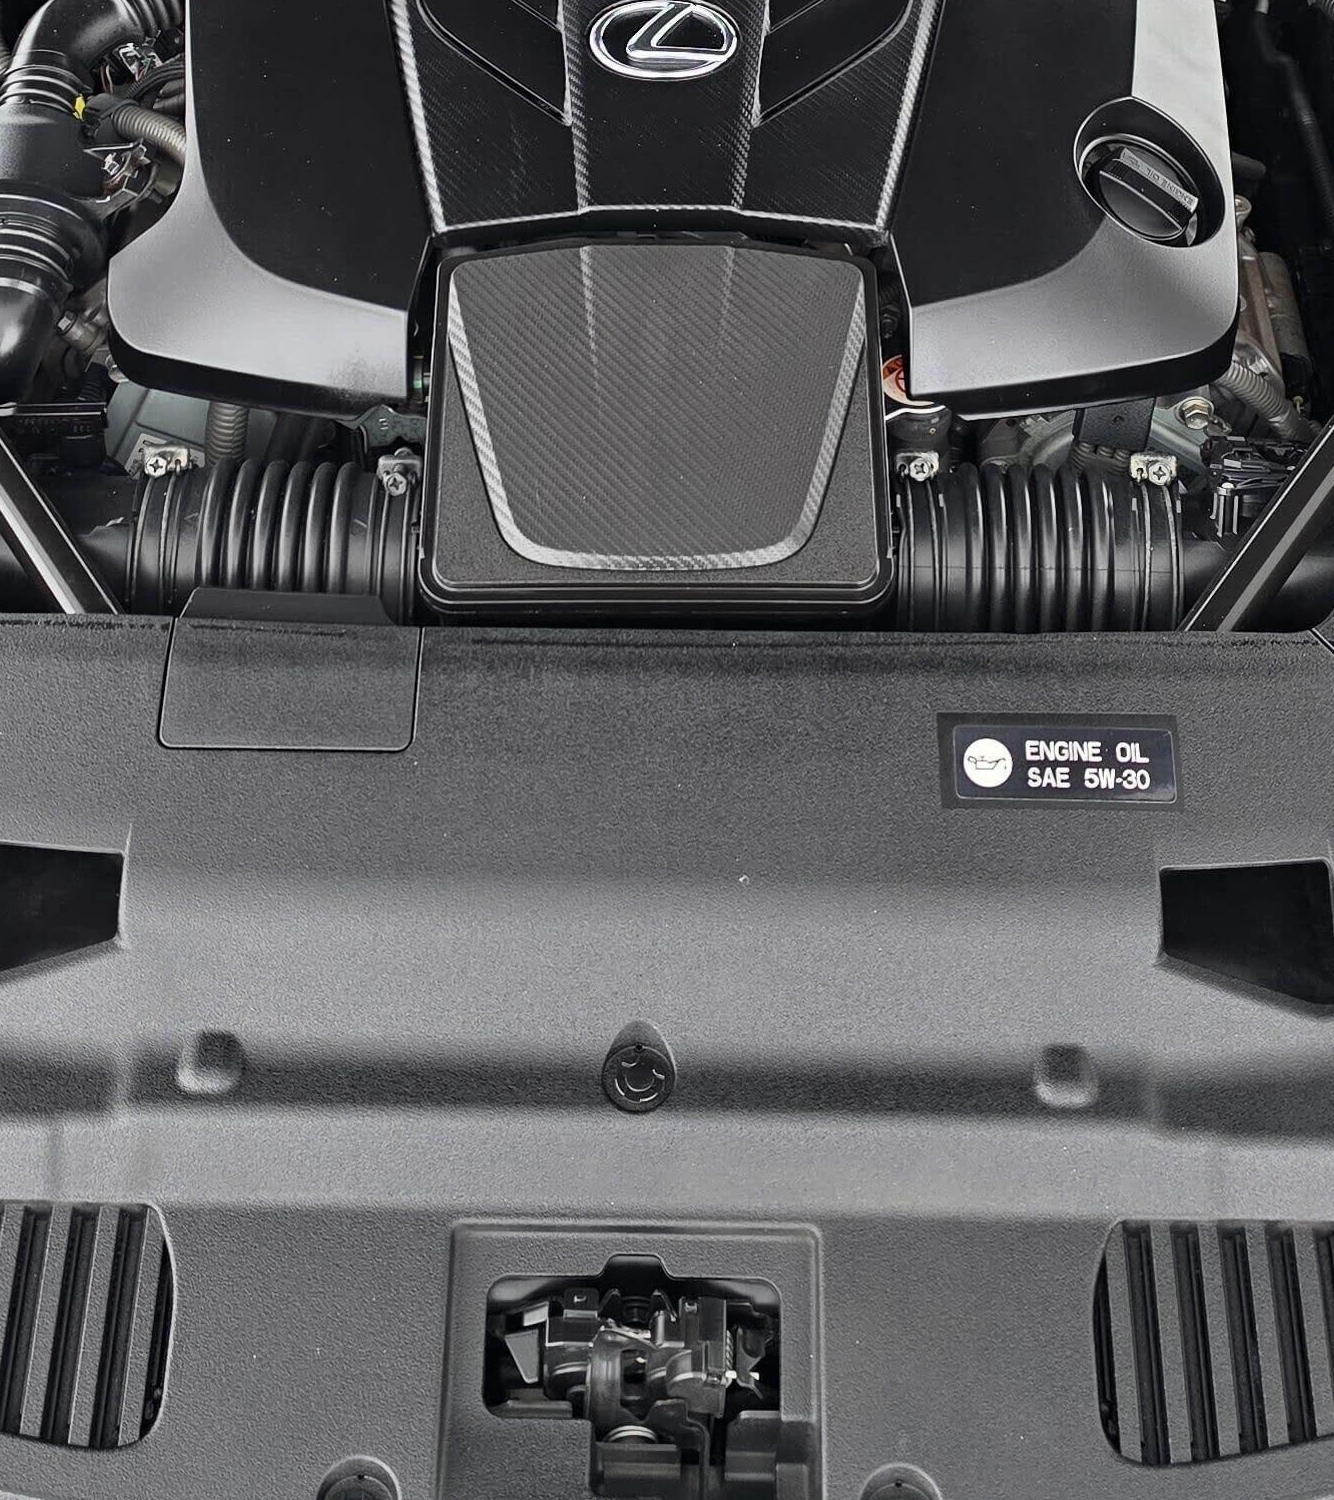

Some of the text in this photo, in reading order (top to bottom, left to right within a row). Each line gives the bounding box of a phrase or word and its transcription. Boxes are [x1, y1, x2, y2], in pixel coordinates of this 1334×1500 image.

[1146, 168, 1195, 205] ENGINE OIL
[1025, 739, 1150, 763] ENGINE OIL
[1027, 766, 1151, 790] SAE 5W-30
